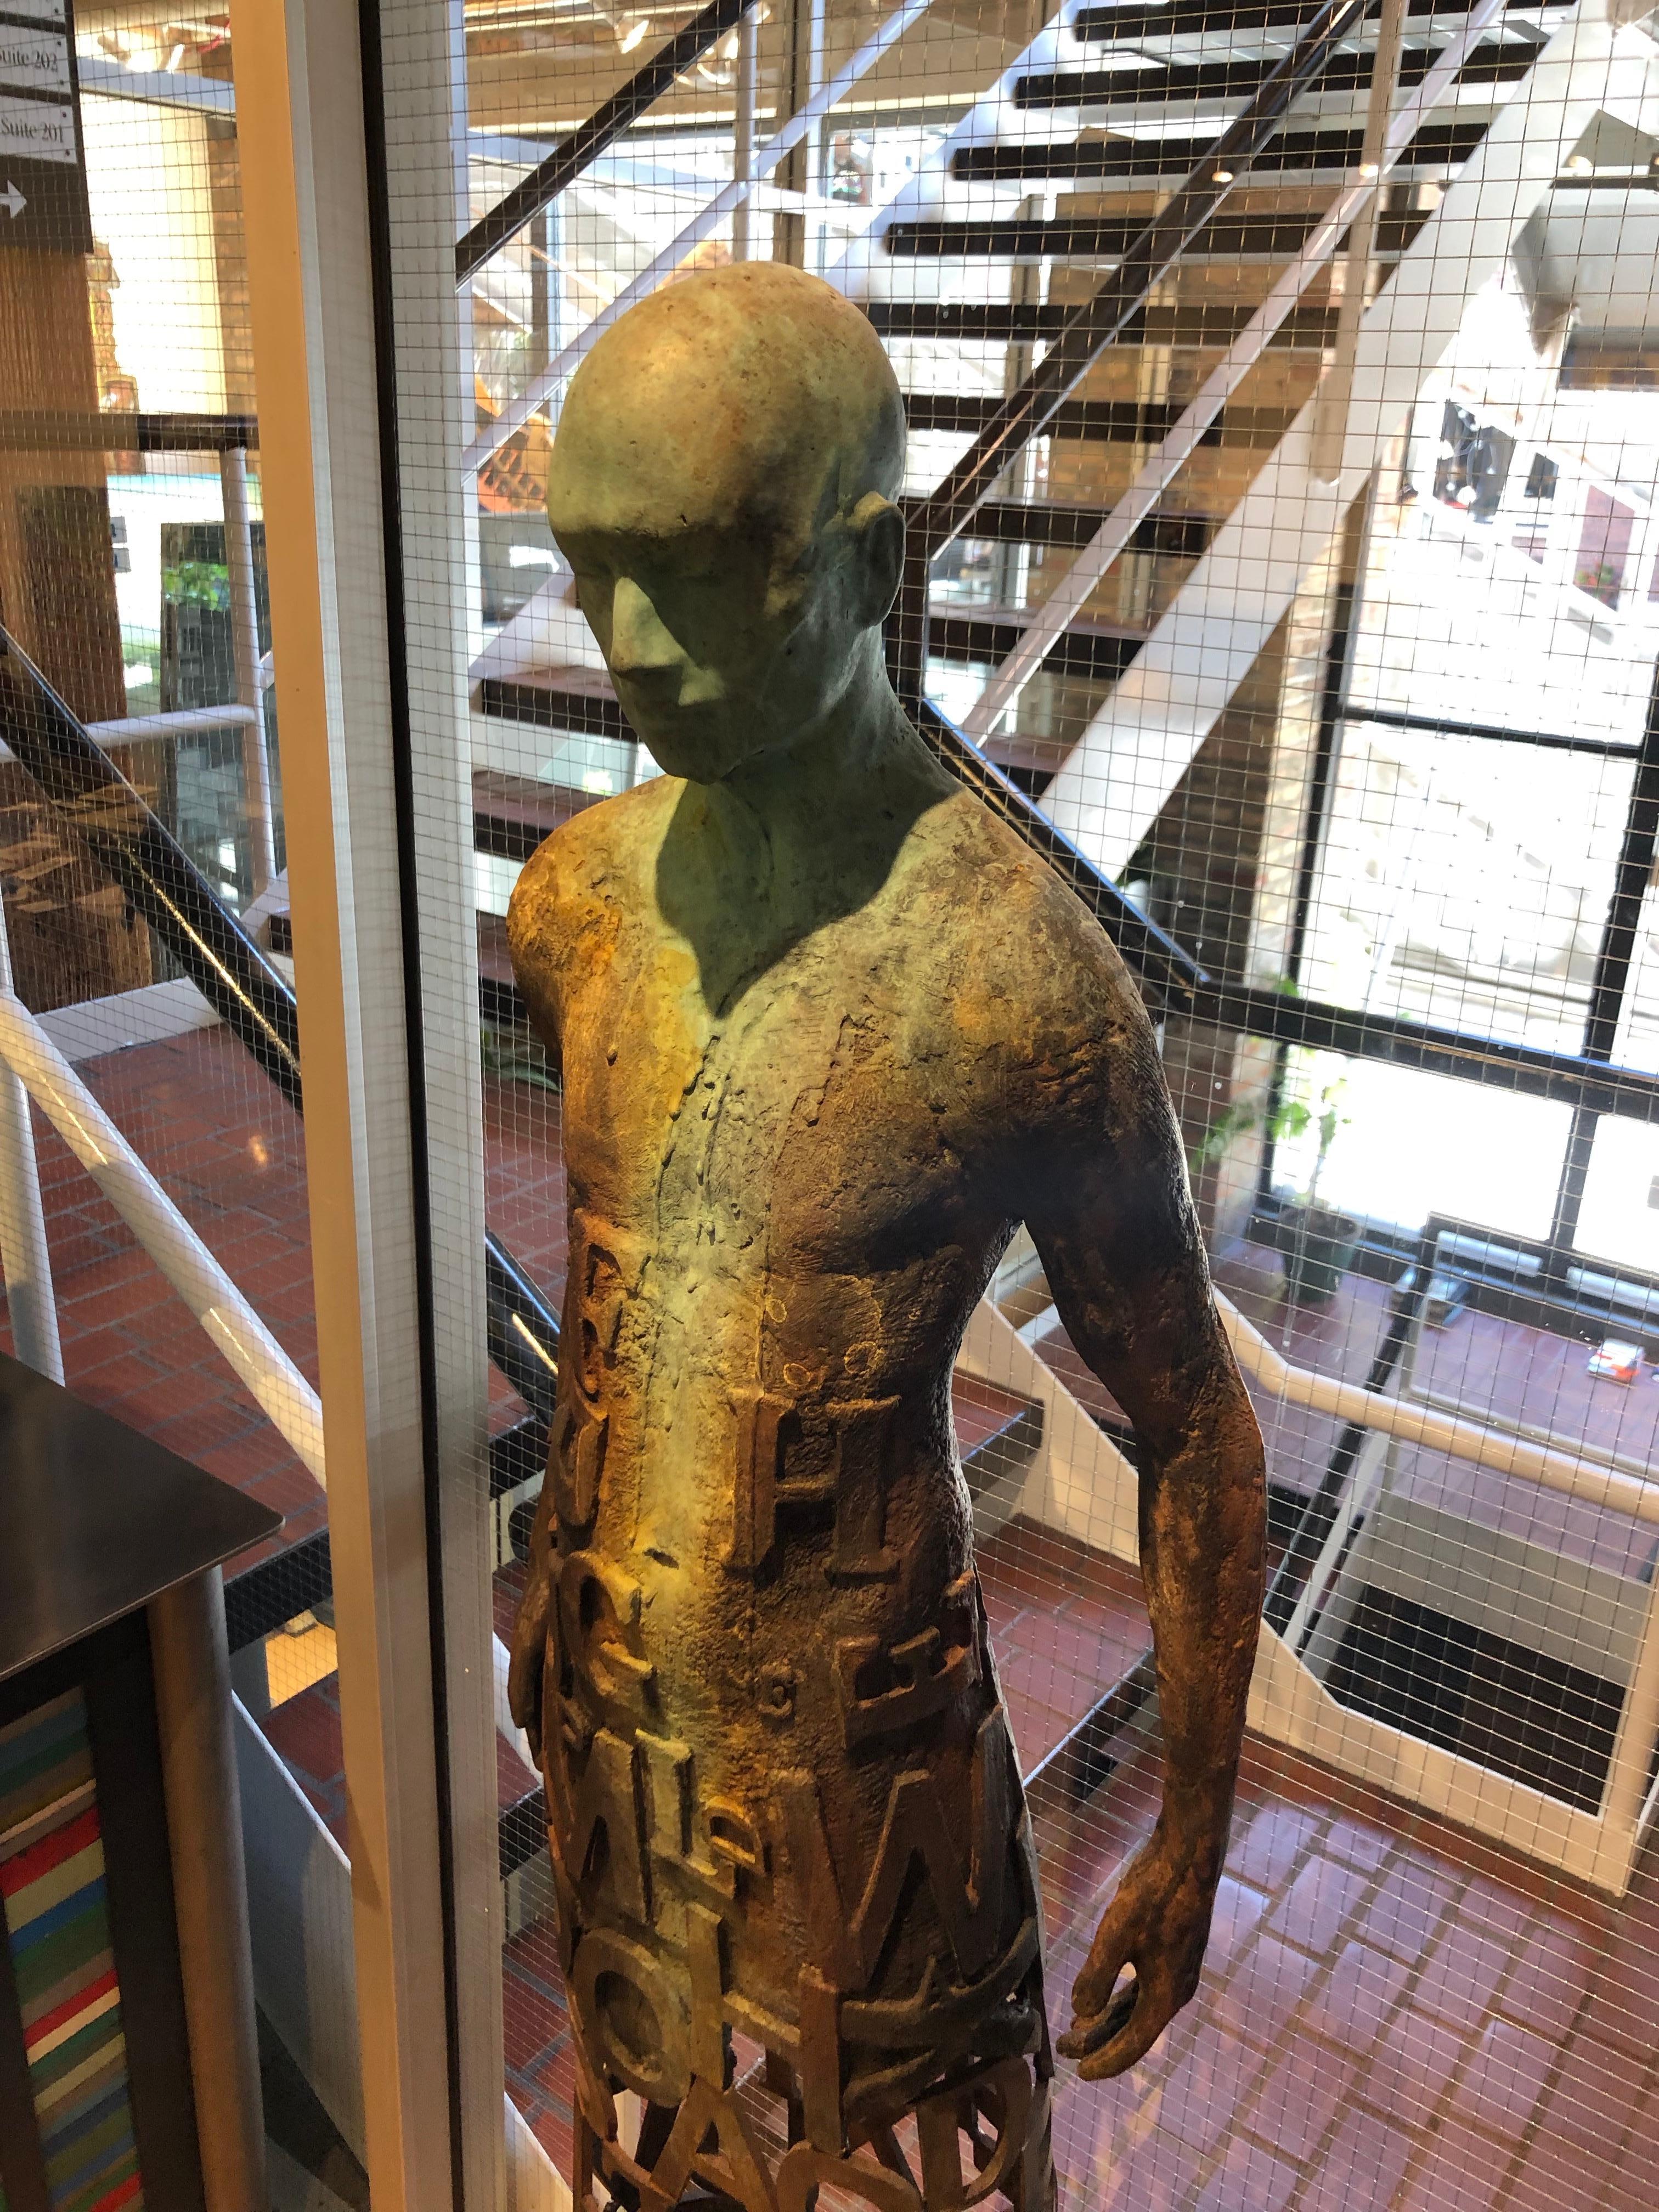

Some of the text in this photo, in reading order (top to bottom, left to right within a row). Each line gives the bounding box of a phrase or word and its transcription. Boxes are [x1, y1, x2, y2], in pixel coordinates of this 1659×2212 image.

[0, 46, 30, 66] uite
[1, 116, 63, 143] Suite 201
